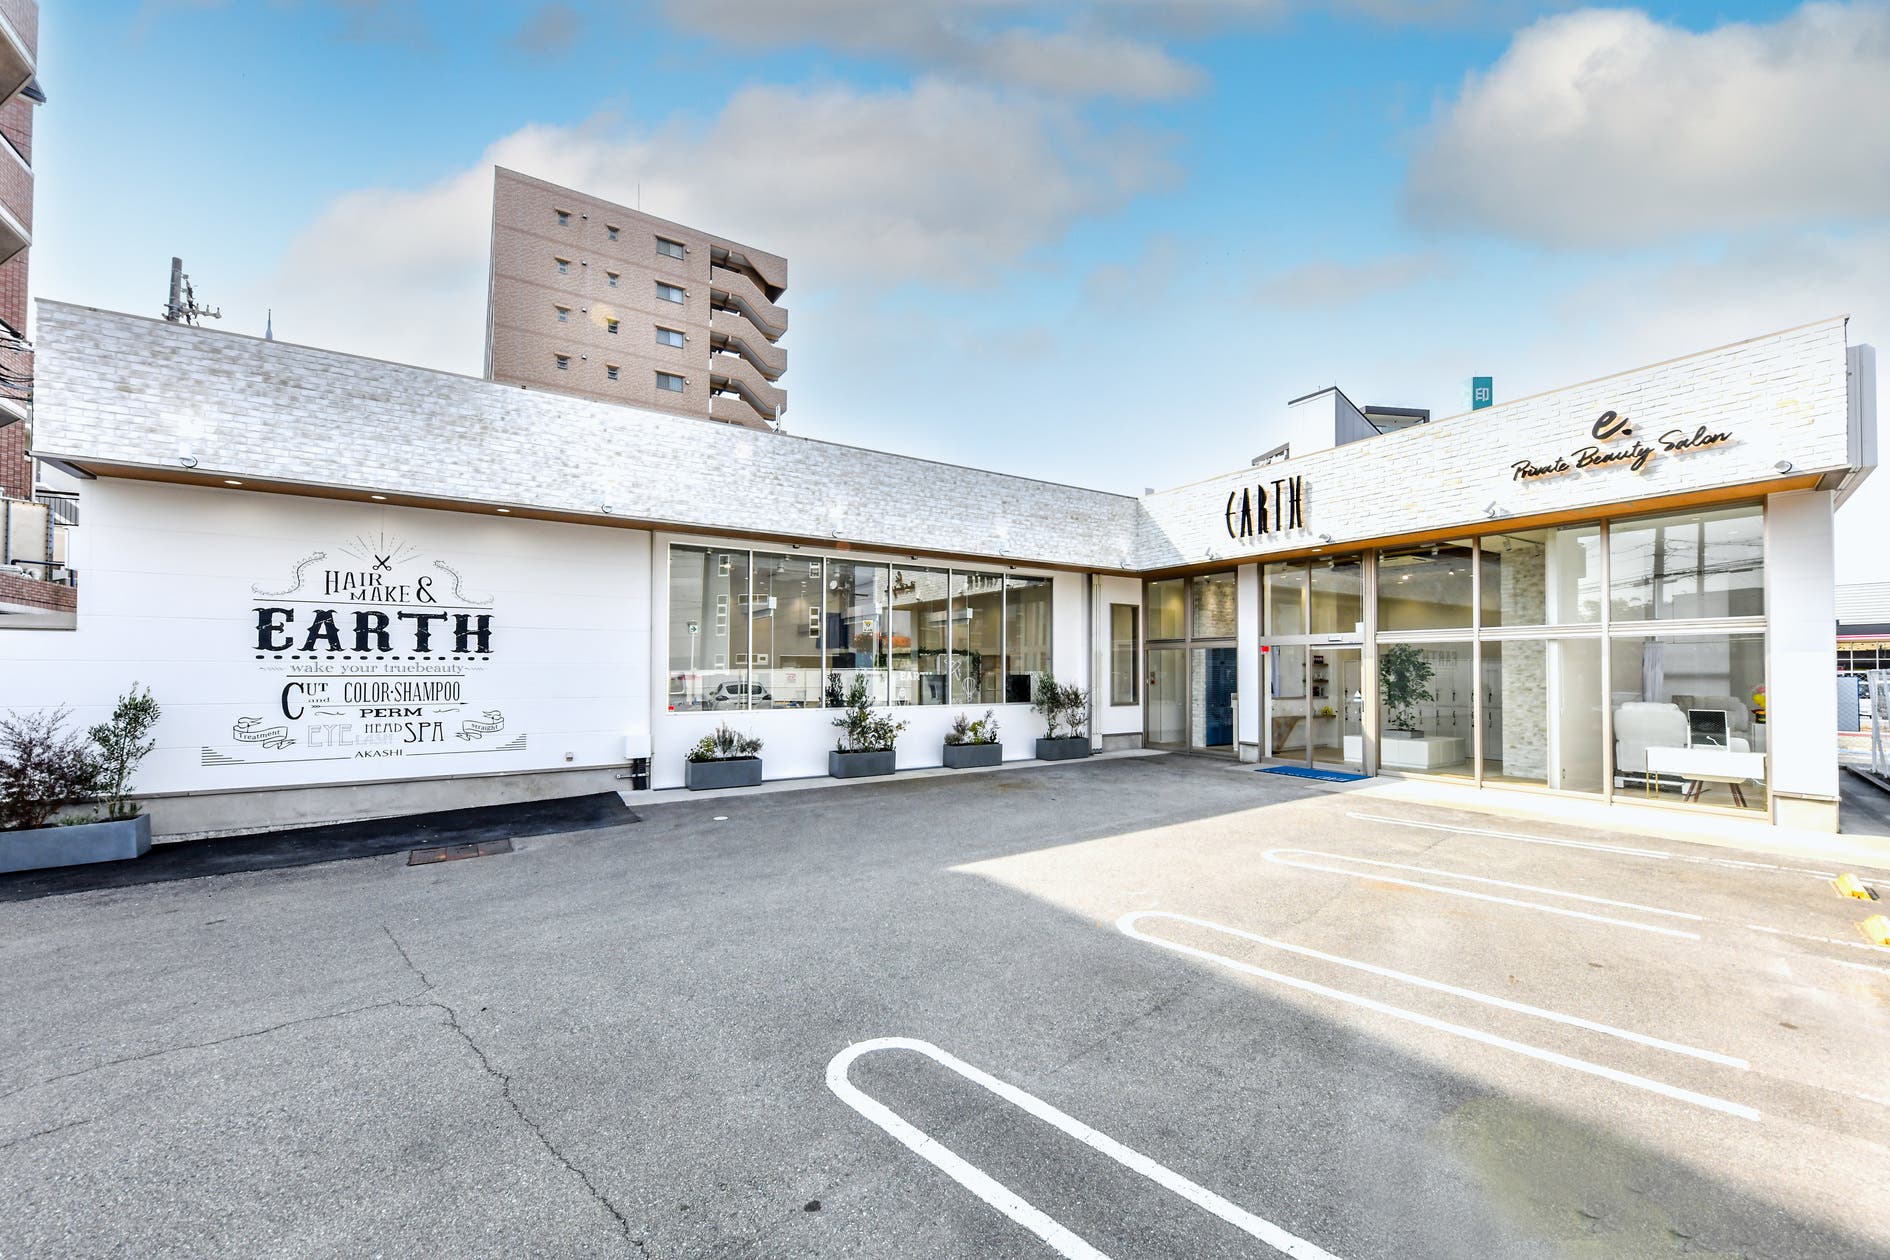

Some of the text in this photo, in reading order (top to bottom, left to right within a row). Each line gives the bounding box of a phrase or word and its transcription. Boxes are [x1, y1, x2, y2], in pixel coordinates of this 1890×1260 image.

[1511, 425, 1733, 481] Private Beauty Salon
[1225, 475, 1302, 539] EARTH
[325, 570, 382, 595] HAIR
[350, 576, 437, 603] MAKE &
[252, 607, 494, 654] EARTH
[289, 661, 464, 675] wake your truebeauty
[282, 682, 329, 720] CUT
[360, 707, 422, 718] PERM
[239, 729, 281, 741] Treatment
[307, 724, 354, 747] EYE
[364, 721, 444, 743] HEAD SPA
[354, 749, 403, 759] AKASHI
